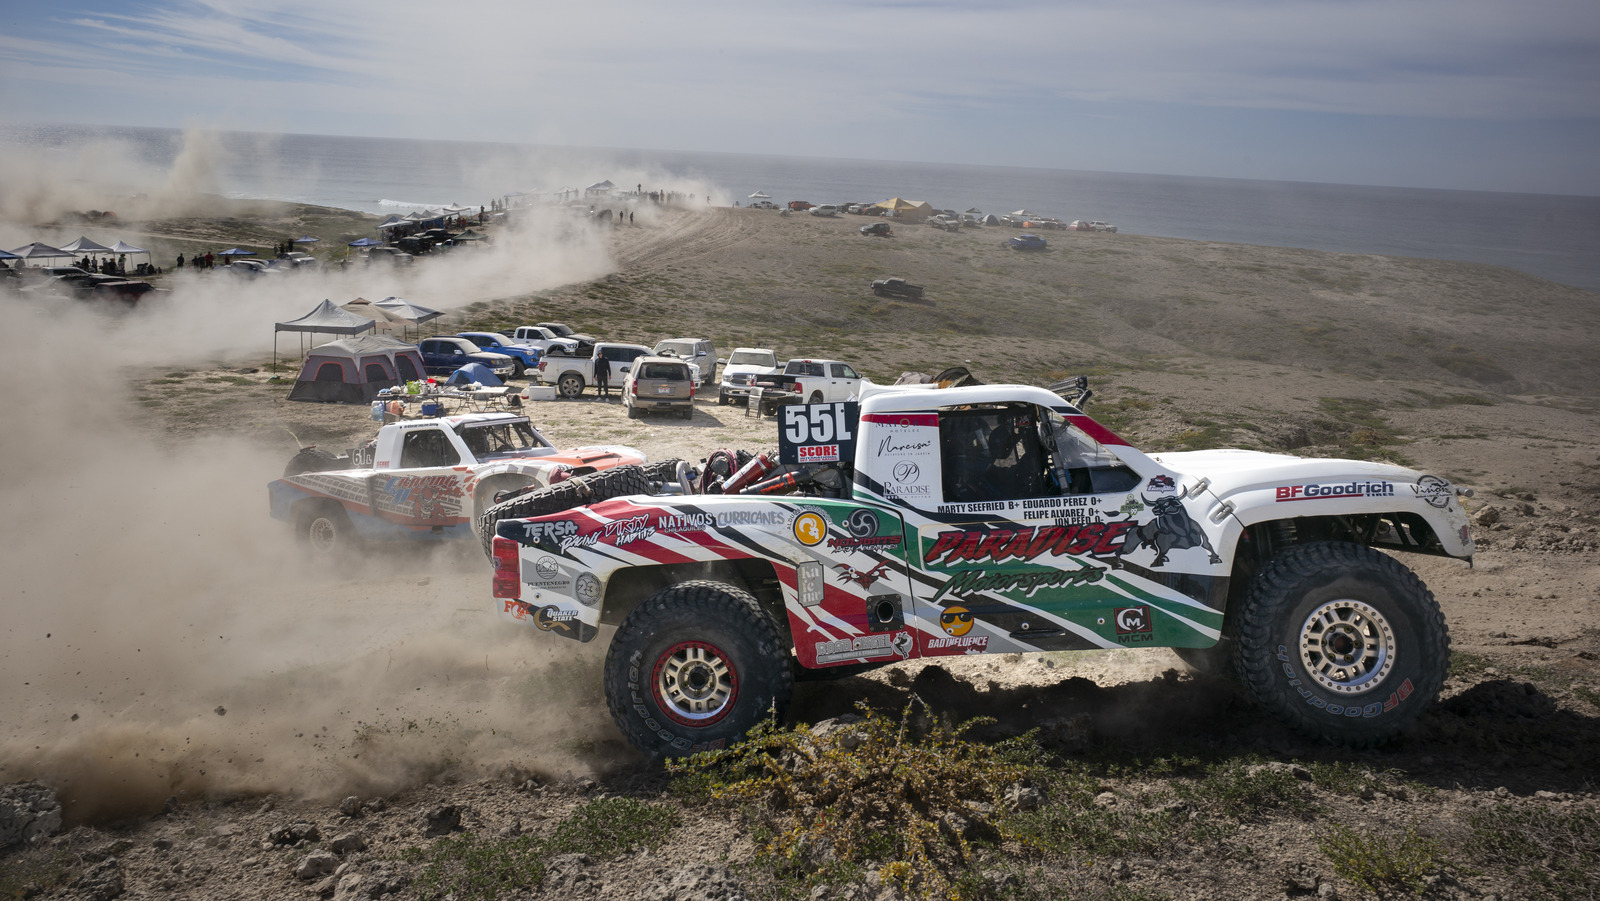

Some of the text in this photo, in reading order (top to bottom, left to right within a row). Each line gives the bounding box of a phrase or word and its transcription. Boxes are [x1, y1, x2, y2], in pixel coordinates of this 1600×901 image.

[785, 403, 852, 444] 55L
[799, 445, 838, 457] SCORE
[884, 482, 931, 494] PARADISE
[1276, 481, 1394, 499] BFGoodrich
[937, 501, 1020, 514] MARTY SEEFRIED B+
[1022, 498, 1062, 509] EDUARDO
[658, 513, 714, 529] NATIVOS
[718, 510, 786, 526] CURRICANES
[1023, 510, 1049, 520] FELIPE
[1050, 508, 1086, 519] ALVAREZ
[522, 520, 579, 543] TERSA
[604, 513, 650, 537] DIRTY
[615, 525, 656, 546] HABITS
[924, 521, 1138, 564] PARADISE
[932, 565, 1107, 602] Motorsports
[504, 600, 533, 616] FOX
[546, 608, 579, 619] QUAKER
[927, 638, 946, 649] BAD
[946, 636, 989, 648] INFLUENCE
[1117, 634, 1153, 643] MCM
[815, 638, 852, 656] ROAD
[1278, 645, 1414, 718] BFGoodrich
